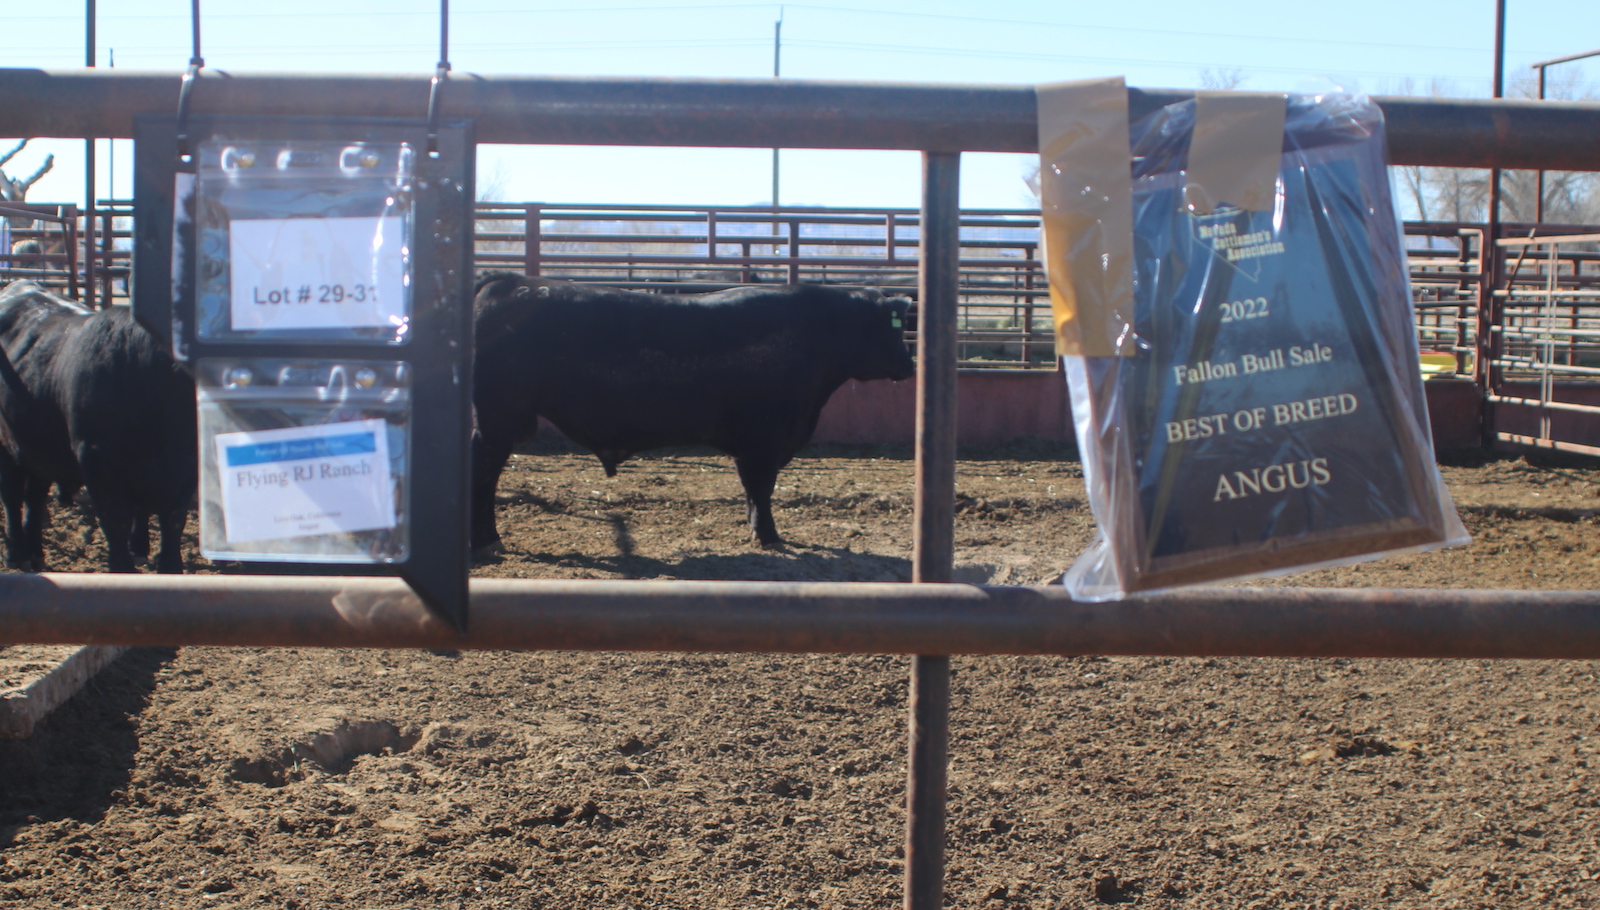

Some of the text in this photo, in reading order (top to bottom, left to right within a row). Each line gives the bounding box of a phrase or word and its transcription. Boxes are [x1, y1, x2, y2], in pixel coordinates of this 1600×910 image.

[1226, 242, 1285, 262] Association
[253, 286, 290, 304] Lot
[297, 287, 311, 304] #
[1218, 297, 1269, 323] 2022
[1173, 342, 1333, 386] Fallon Bull Sale
[1165, 393, 1358, 443] BEST OF BREED
[237, 459, 372, 489] Flying RJ Ranch
[1213, 457, 1331, 502] ANGUS
